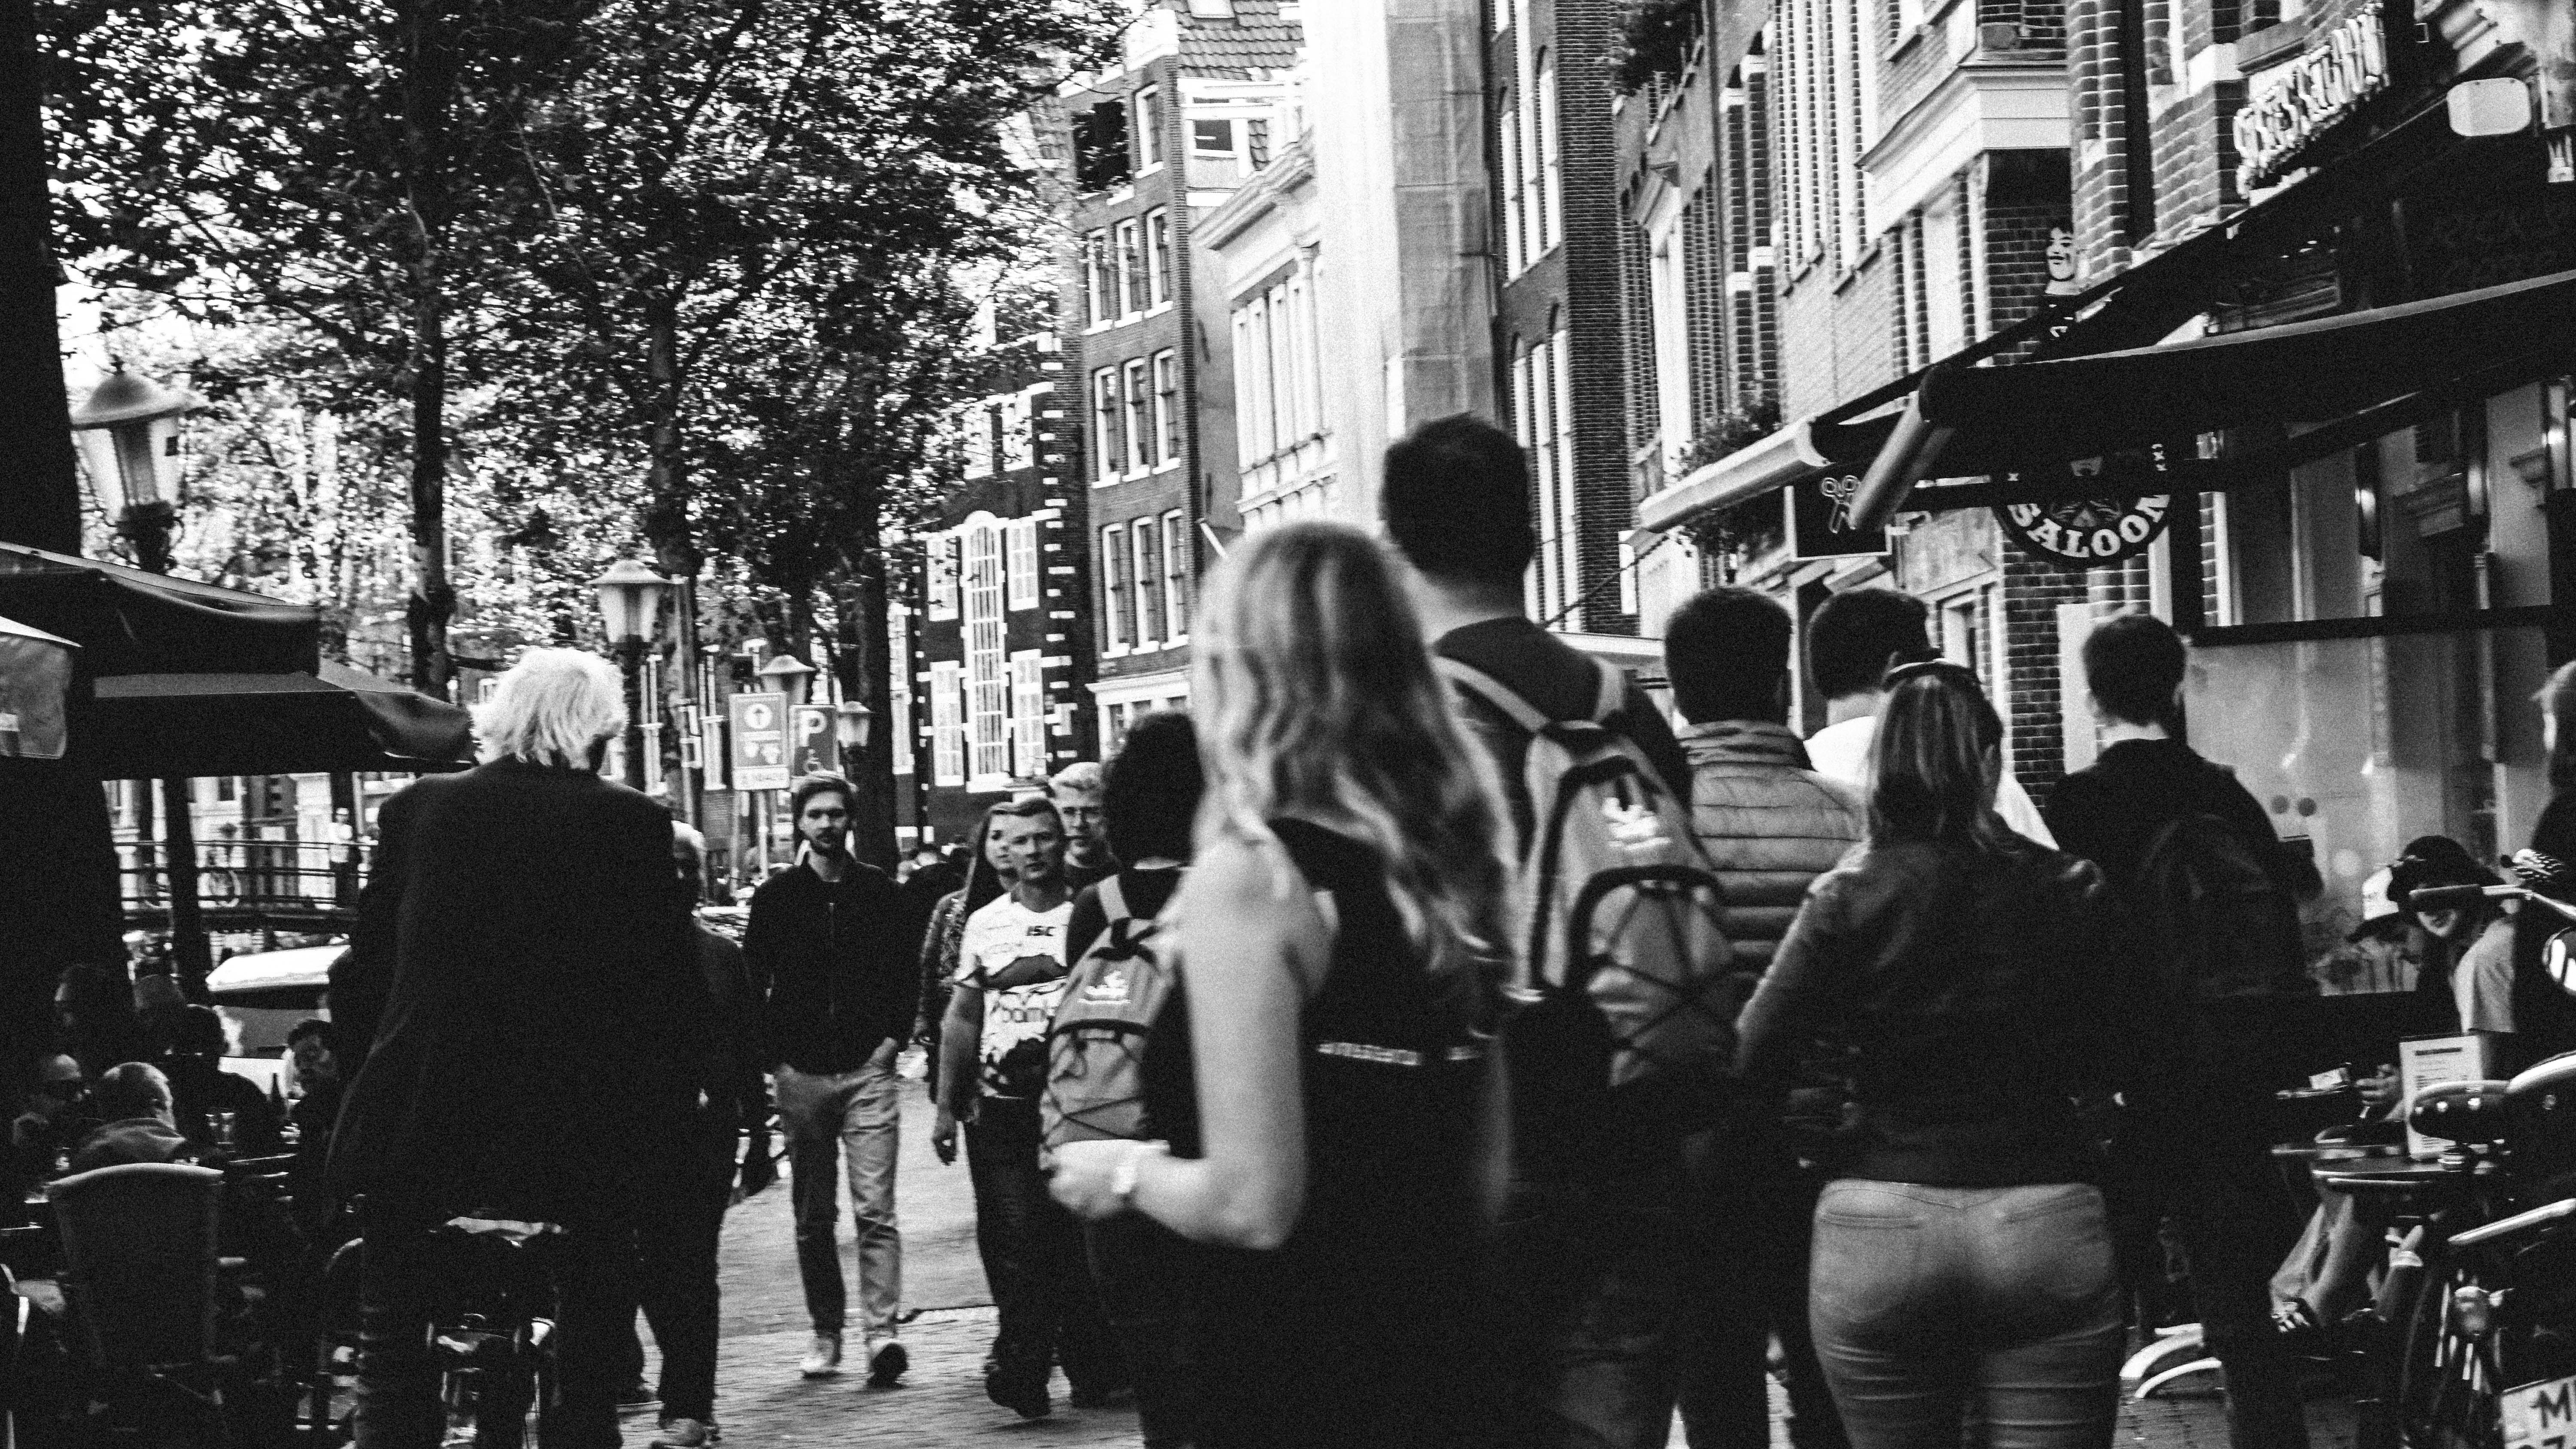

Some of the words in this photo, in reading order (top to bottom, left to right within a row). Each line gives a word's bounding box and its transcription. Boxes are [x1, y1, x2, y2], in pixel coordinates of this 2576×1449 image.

[2007, 494, 2170, 558] SALOON
[799, 711, 827, 747] P
[2537, 1379, 2576, 1428] M
